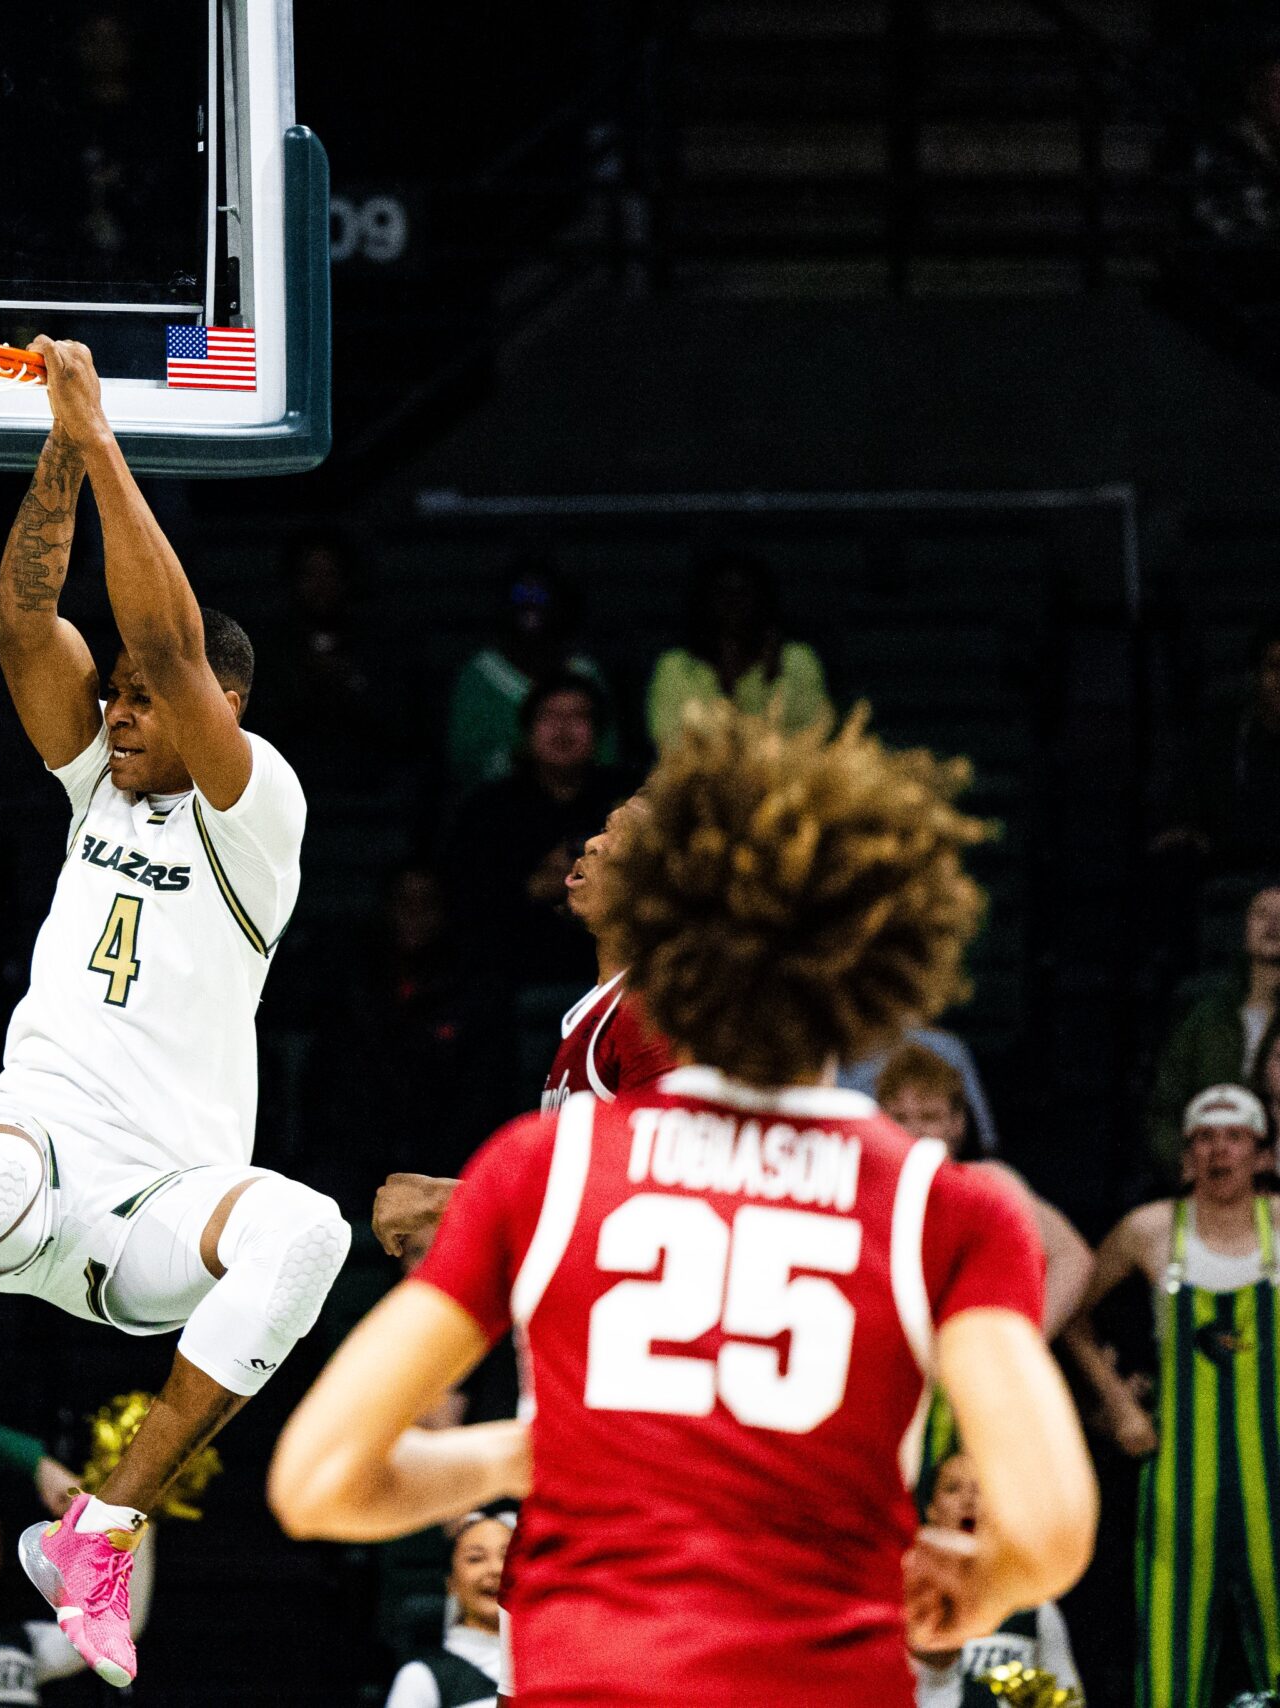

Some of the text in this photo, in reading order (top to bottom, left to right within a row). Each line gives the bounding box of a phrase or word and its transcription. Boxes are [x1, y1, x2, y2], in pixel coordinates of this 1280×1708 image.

[88, 893, 144, 1008] 4
[627, 1107, 862, 1212] TOBIASON
[583, 1192, 864, 1436] 25
